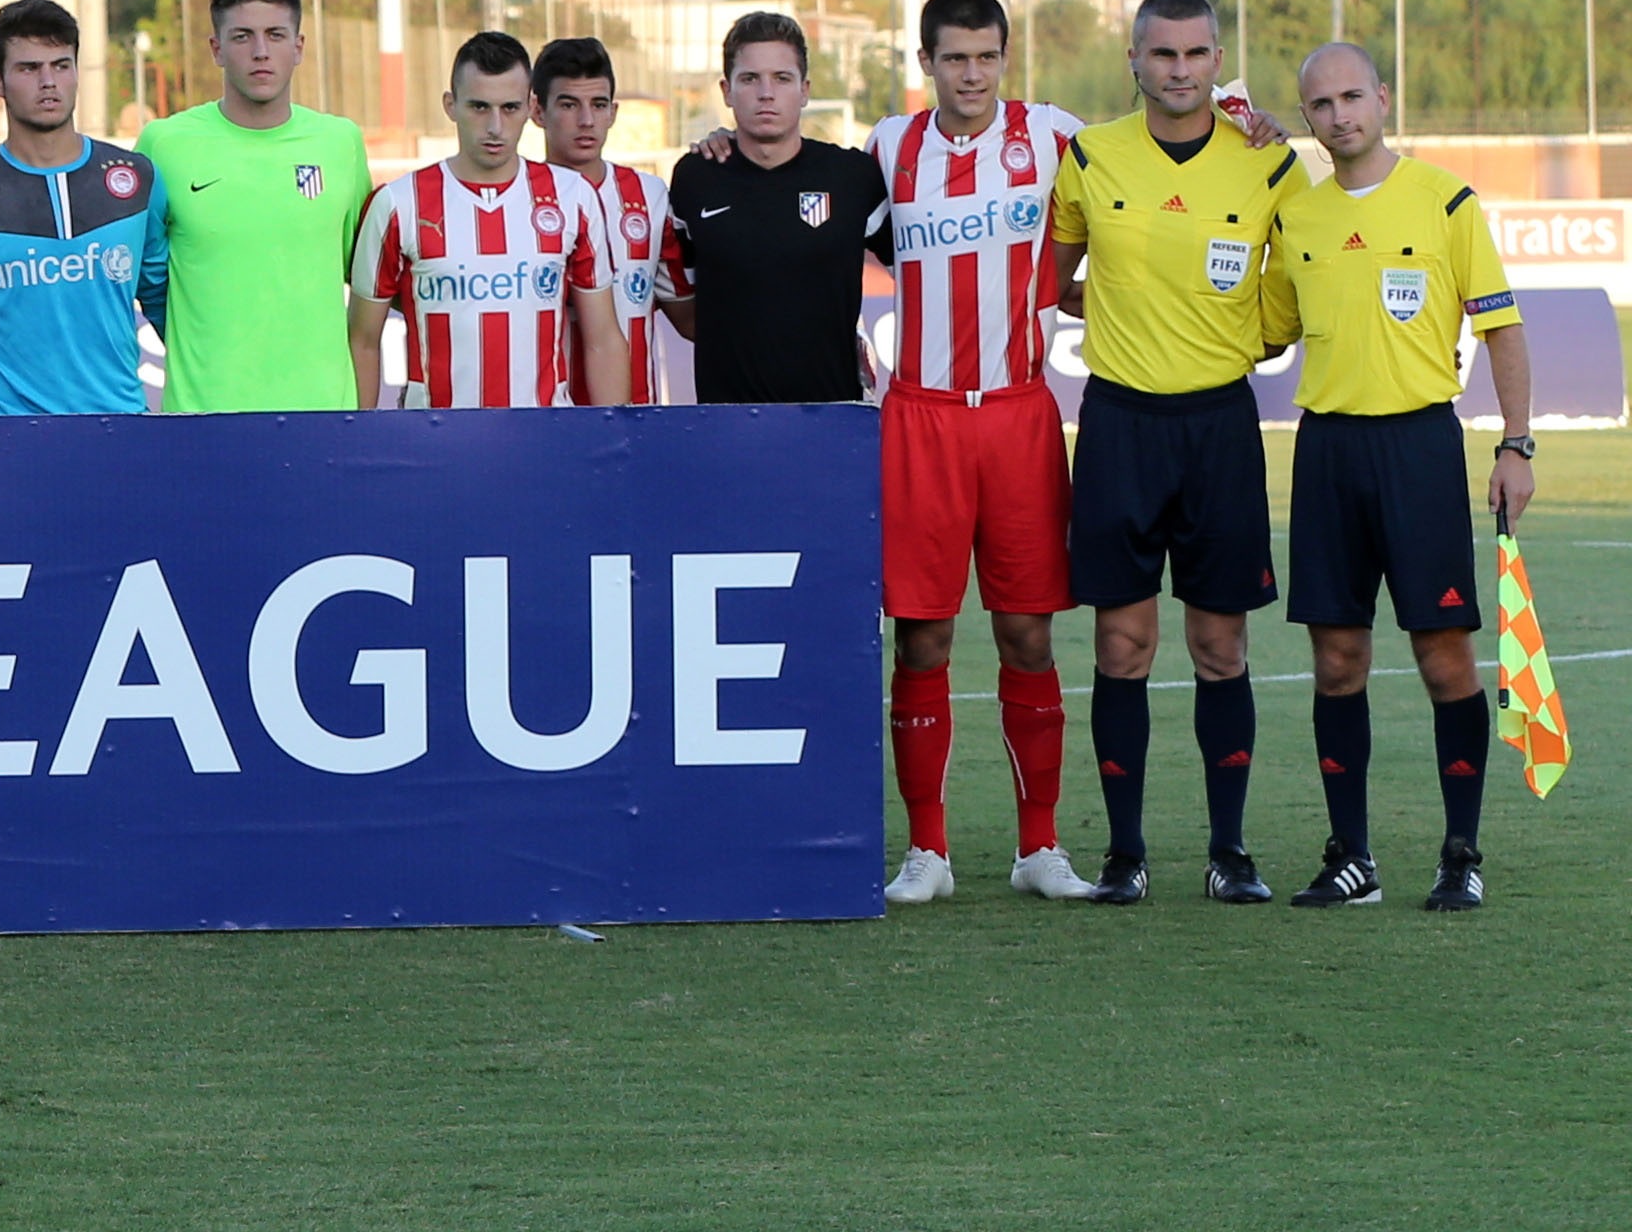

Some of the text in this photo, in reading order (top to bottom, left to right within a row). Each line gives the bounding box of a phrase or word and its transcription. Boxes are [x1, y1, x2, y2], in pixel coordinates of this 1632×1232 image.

[894, 200, 998, 252] unicef
[1489, 210, 1617, 256] irates
[1211, 242, 1247, 253] REFEREE
[1210, 258, 1242, 273] FIFA
[417, 261, 529, 302] unicef
[1387, 289, 1420, 301] FIFA
